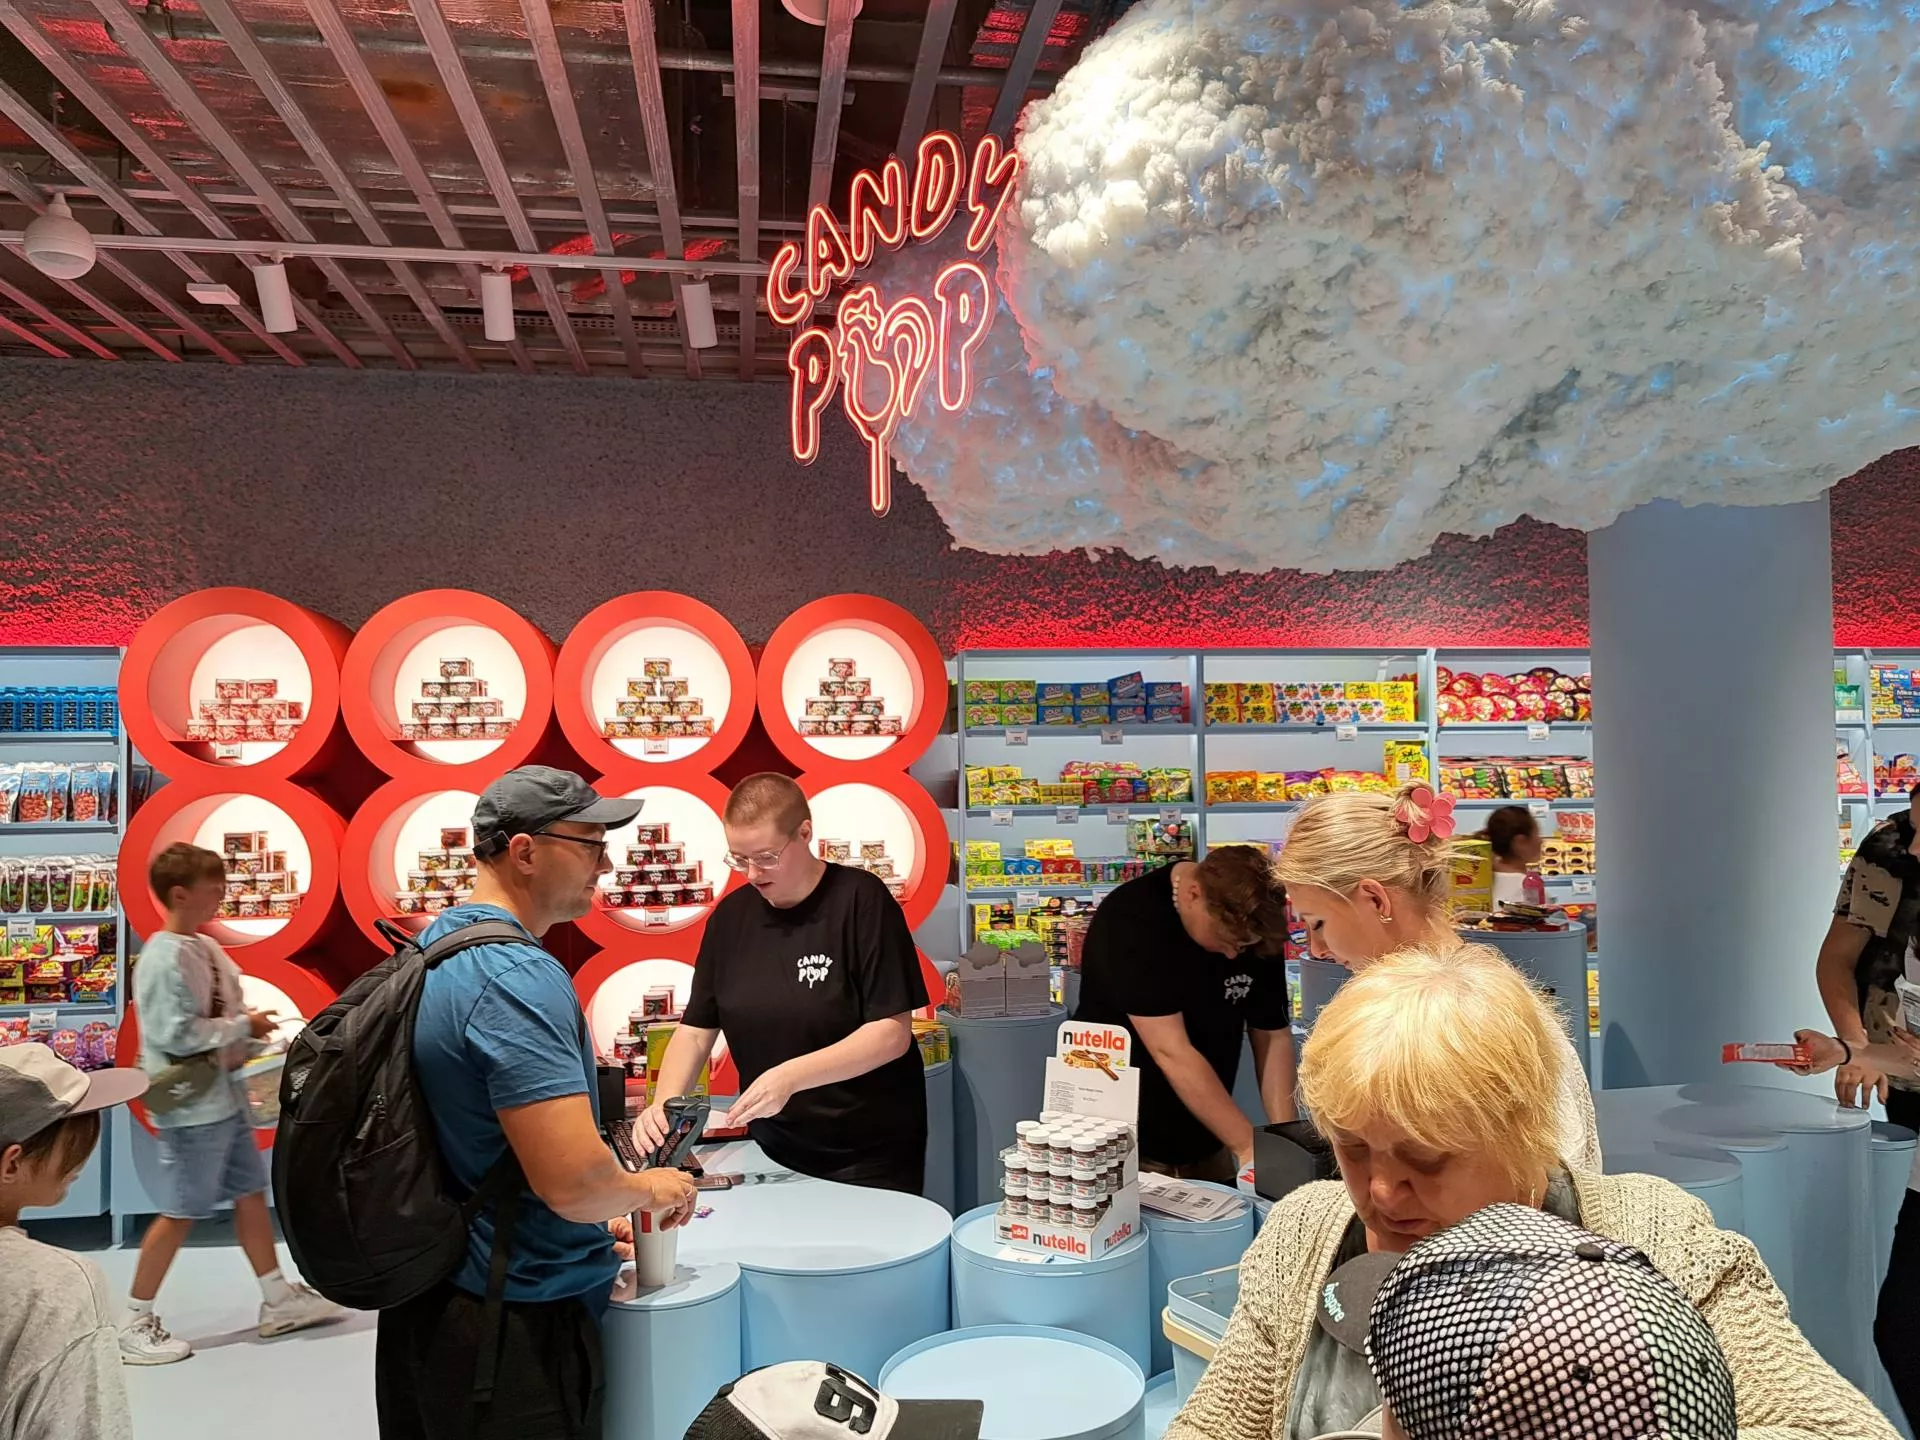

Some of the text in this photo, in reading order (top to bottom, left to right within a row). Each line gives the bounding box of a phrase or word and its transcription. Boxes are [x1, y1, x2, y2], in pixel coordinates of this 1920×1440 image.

[767, 130, 1019, 326] CANDY
[797, 954, 833, 968] CANDY
[1063, 1030, 1125, 1051] nutella
[1033, 1233, 1086, 1255] nutella
[1104, 1223, 1132, 1250] nutella
